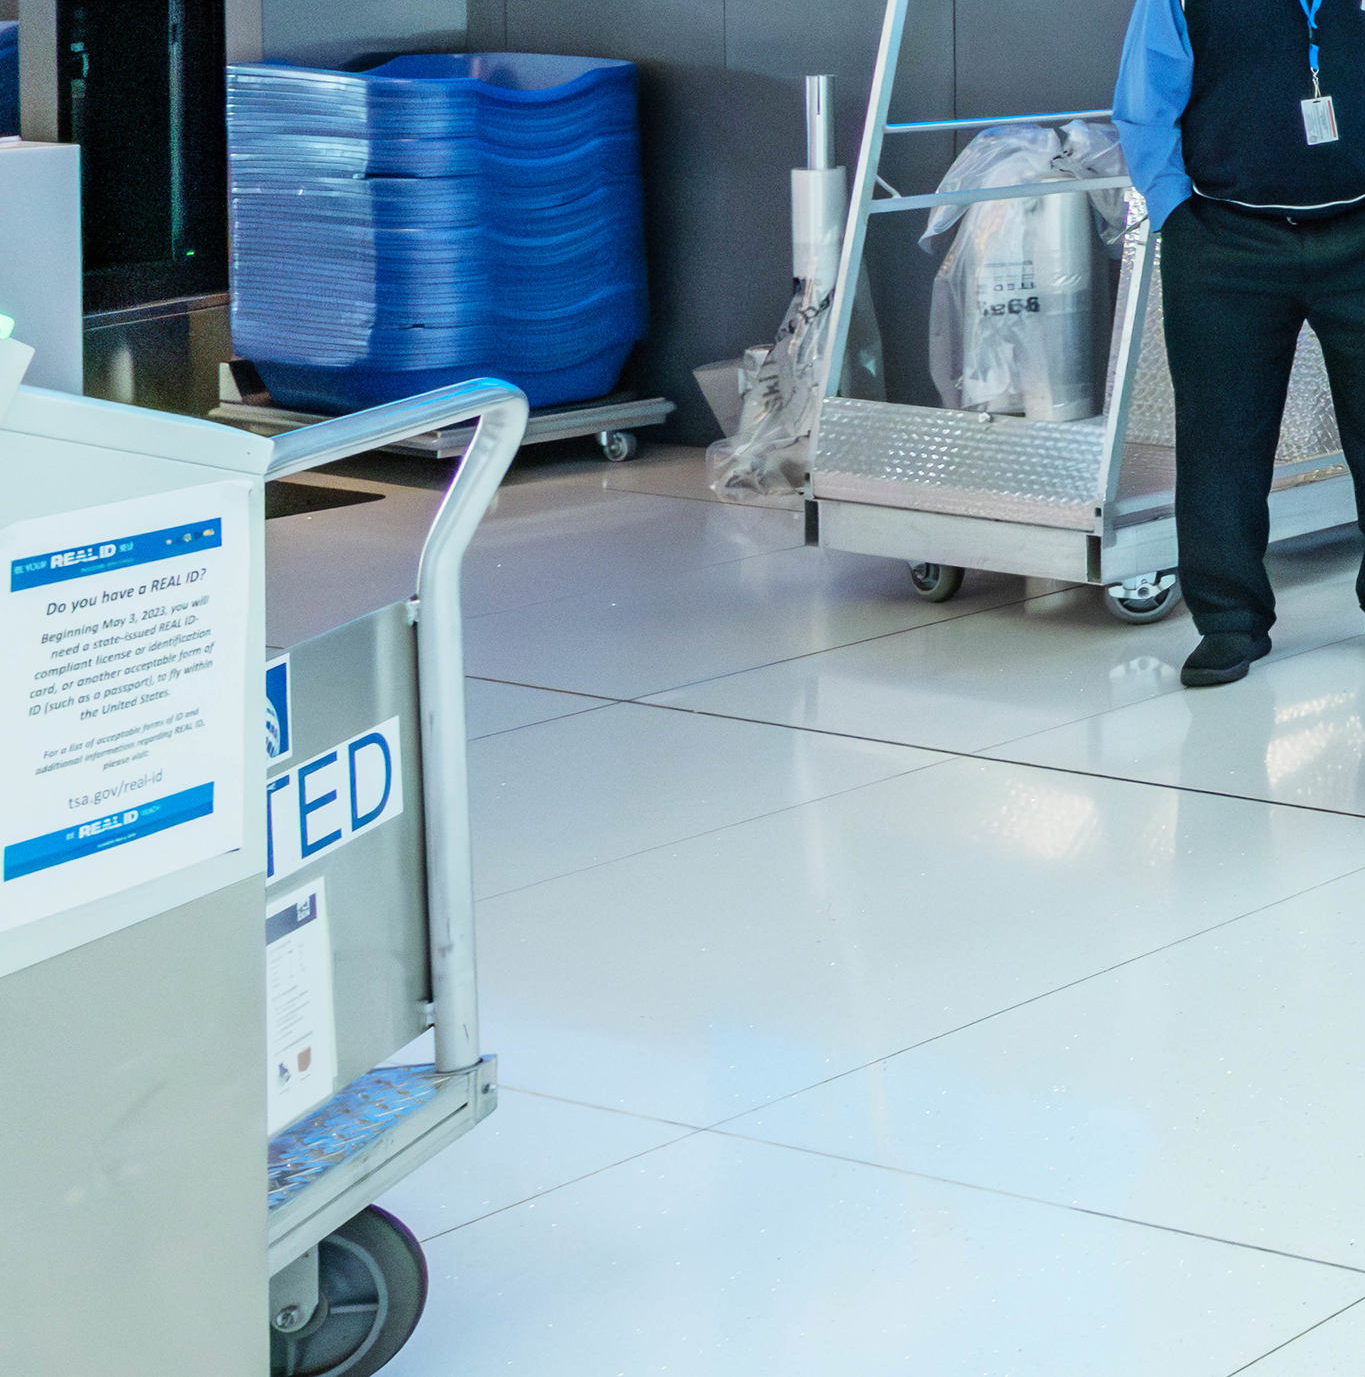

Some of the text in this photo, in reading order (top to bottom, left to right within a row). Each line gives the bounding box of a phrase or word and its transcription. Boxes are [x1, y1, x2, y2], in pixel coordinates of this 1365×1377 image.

[50, 547, 99, 569] REAL
[99, 543, 117, 559] ID
[46, 568, 207, 616] Do you have a REAL ID?
[41, 623, 99, 645] Beginning
[102, 616, 125, 630] May
[128, 614, 137, 625] 3,
[171, 604, 188, 616] you
[191, 595, 210, 608] will
[50, 644, 79, 659] need
[93, 626, 157, 650] state-issued
[158, 619, 182, 632] REAL
[29, 641, 216, 699] card, or another acceptable form of
[34, 628, 212, 680] compliant license or identification
[28, 704, 42, 717] ID
[44, 695, 74, 715] (such
[78, 693, 91, 704] as
[93, 691, 101, 700] a
[157, 673, 167, 683] to
[169, 666, 181, 680] fly
[184, 659, 213, 674] within
[80, 688, 171, 721] the United States.
[68, 769, 164, 810] tsa.gov/real-id
[266, 731, 392, 879] TED
[123, 810, 139, 825] ID
